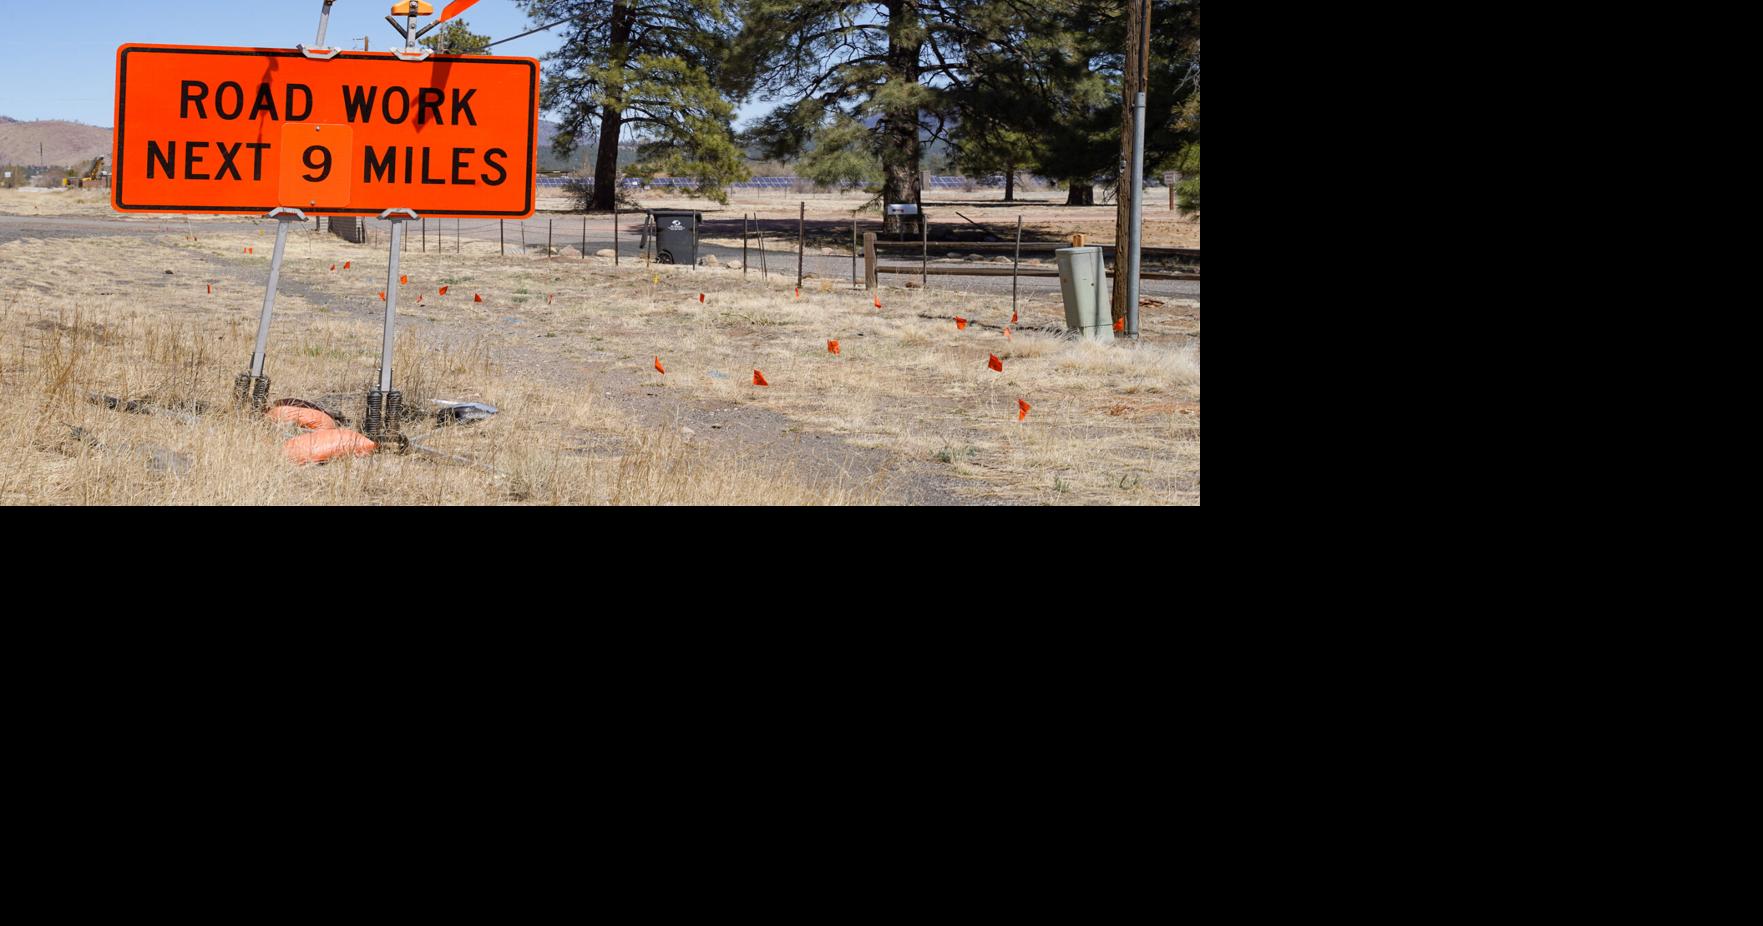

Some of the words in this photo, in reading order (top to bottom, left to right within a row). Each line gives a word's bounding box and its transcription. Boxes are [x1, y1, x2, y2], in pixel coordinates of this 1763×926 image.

[180, 81, 312, 121] ROAD
[343, 86, 476, 125] WORK
[147, 141, 270, 180] NEXT
[303, 146, 331, 182] 9
[364, 146, 507, 185] MILES
